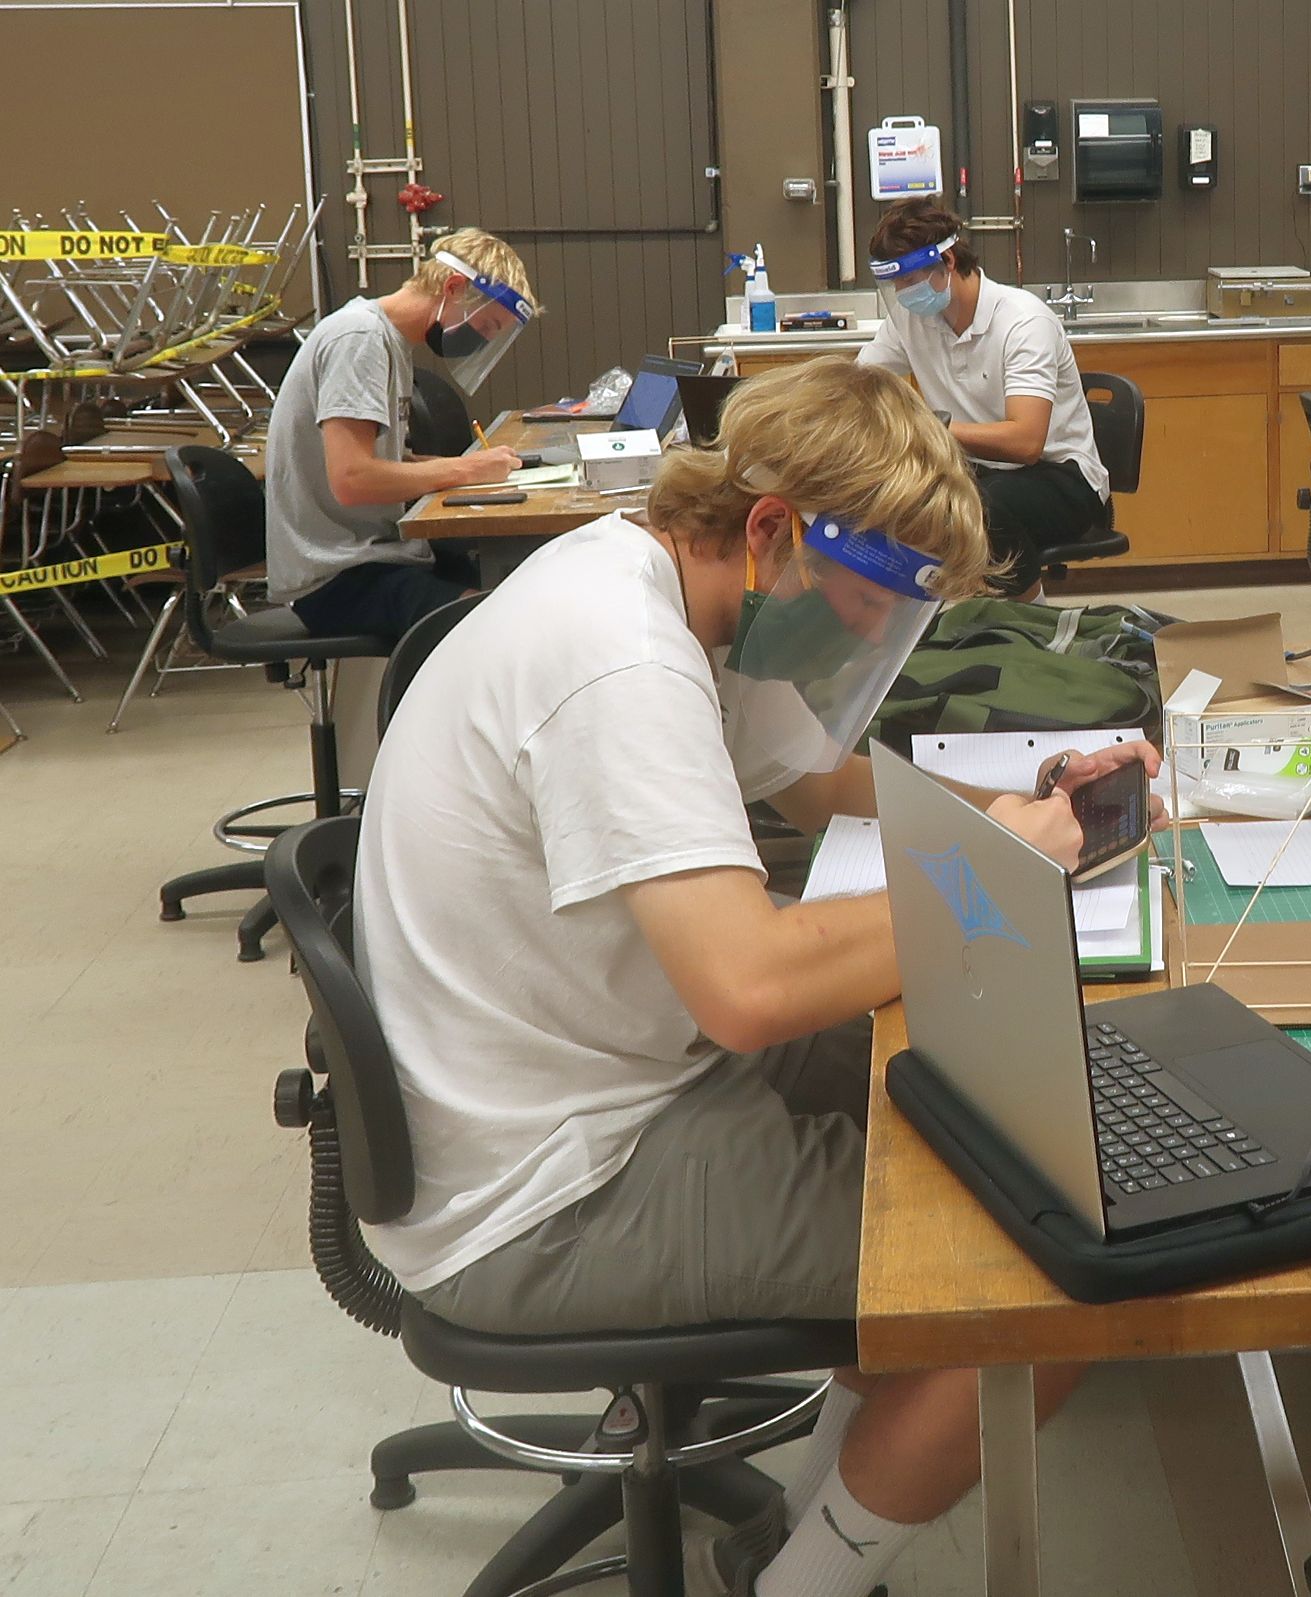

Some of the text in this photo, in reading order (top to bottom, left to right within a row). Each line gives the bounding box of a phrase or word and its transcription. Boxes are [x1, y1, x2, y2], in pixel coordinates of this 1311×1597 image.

[61, 236, 91, 255] DO
[100, 236, 144, 254] NOT
[129, 548, 158, 570] DO
